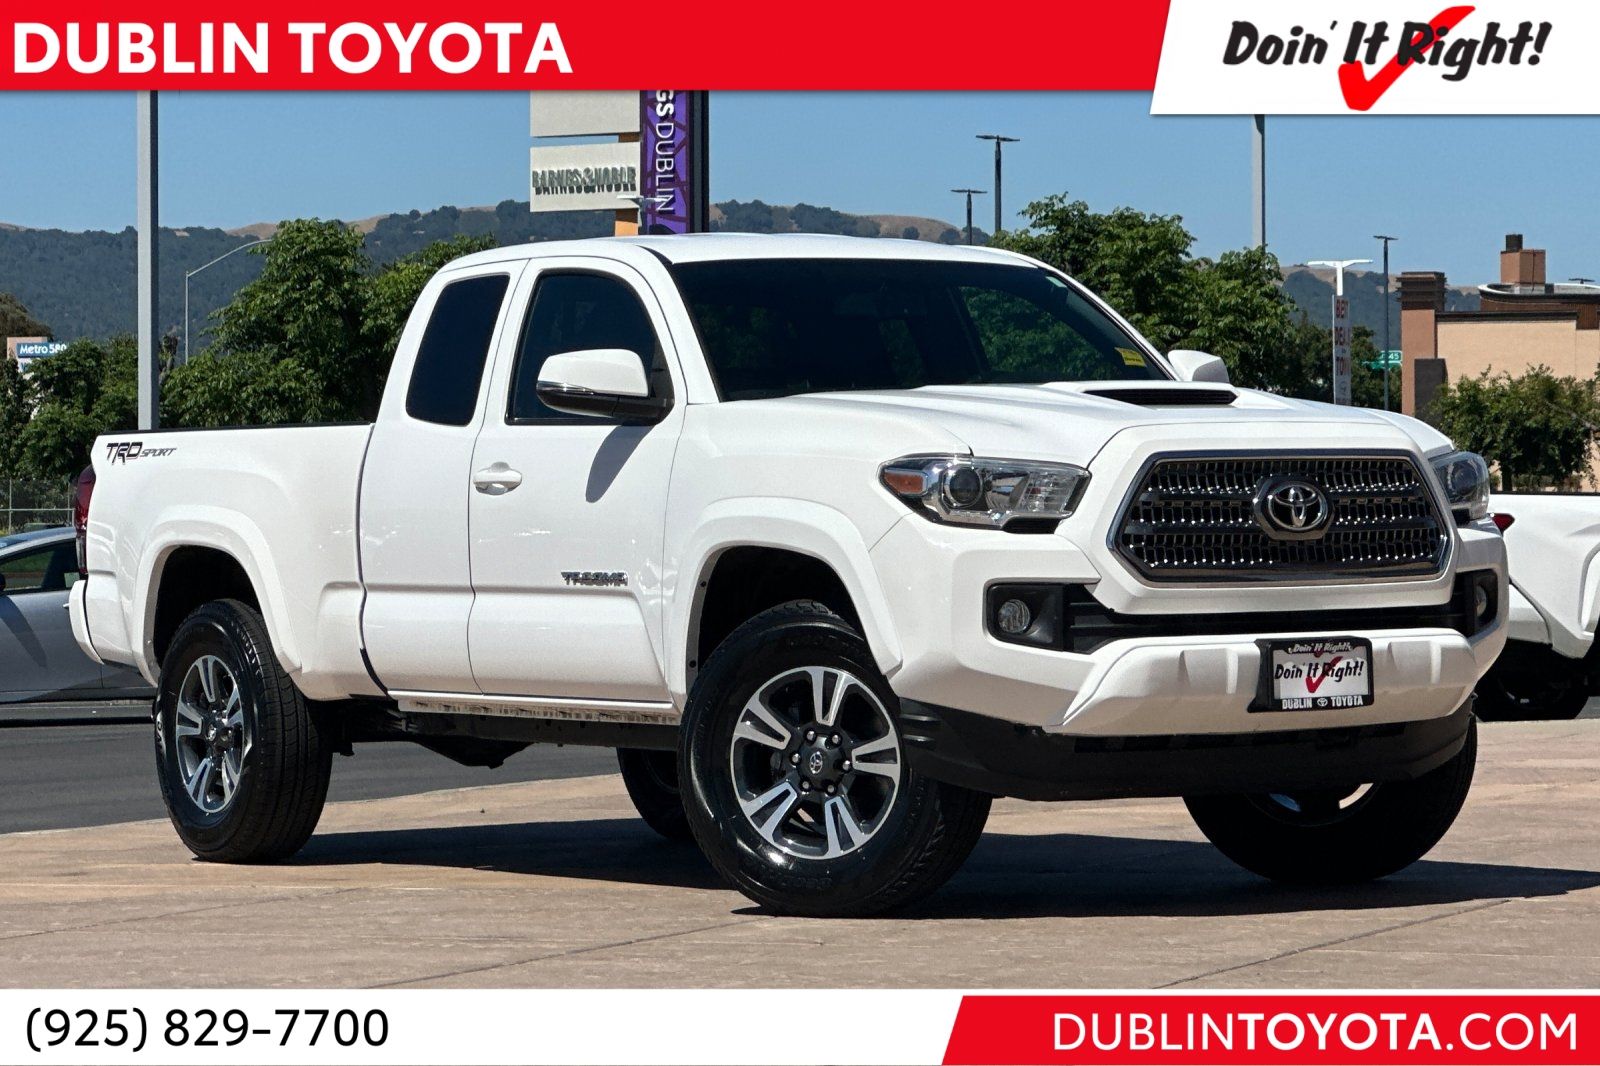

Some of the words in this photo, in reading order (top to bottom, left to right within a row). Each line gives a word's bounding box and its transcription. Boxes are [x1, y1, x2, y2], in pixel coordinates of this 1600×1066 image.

[655, 122, 676, 215] DUBLIN
[20, 344, 48, 354] Metro
[106, 441, 143, 465] TRD
[140, 447, 177, 458] SPORT
[1306, 662, 1320, 678] It
[1322, 660, 1365, 683] Right!
[1281, 697, 1313, 710] DUBLIN
[1330, 695, 1364, 708] TOYOTA
